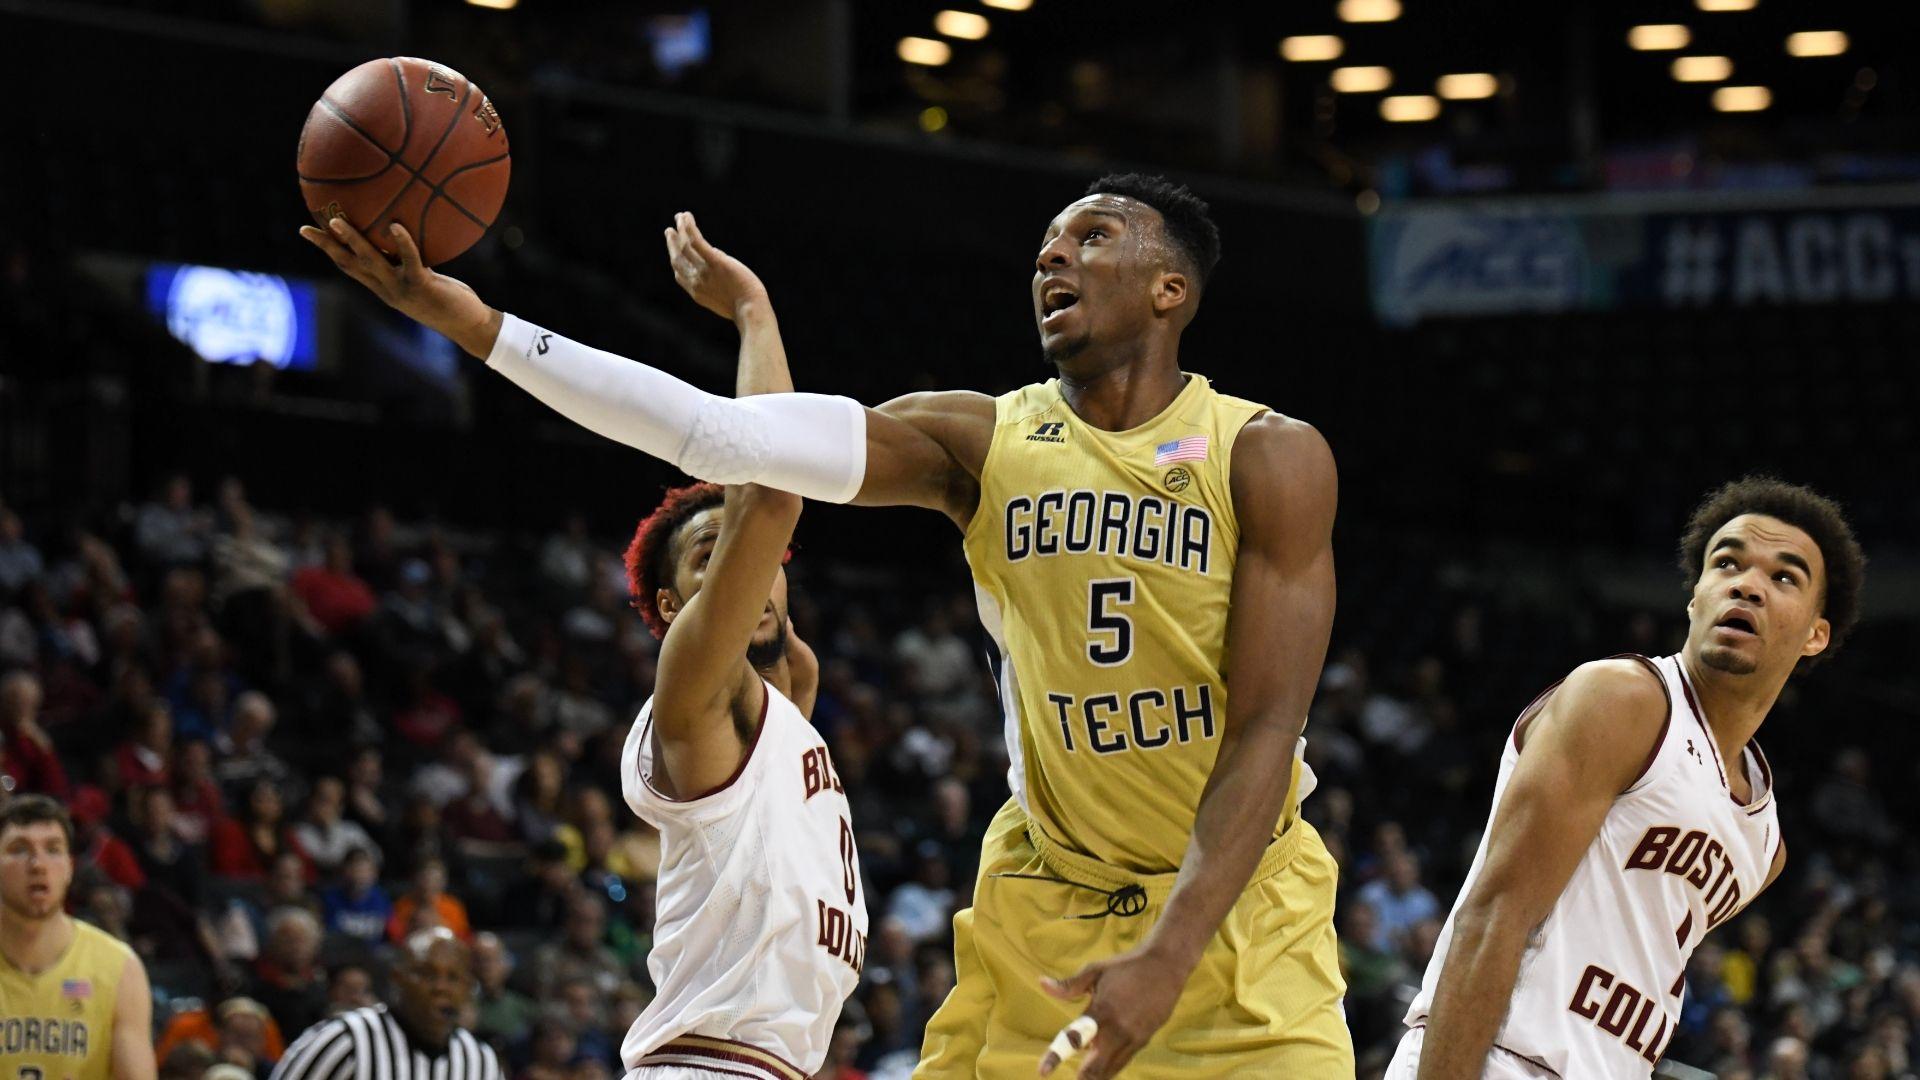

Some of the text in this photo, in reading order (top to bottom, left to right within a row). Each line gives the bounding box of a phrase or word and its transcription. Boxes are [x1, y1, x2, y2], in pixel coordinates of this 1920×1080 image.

[1663, 212, 1920, 303] #ACC
[1026, 434, 1066, 444] RUSSELL
[1004, 489, 1212, 577] GEORGIA
[1087, 577, 1136, 668] 5
[1047, 683, 1216, 755] TECH
[1623, 826, 1741, 930] BOSTO
[1569, 964, 1679, 1066] COLL
